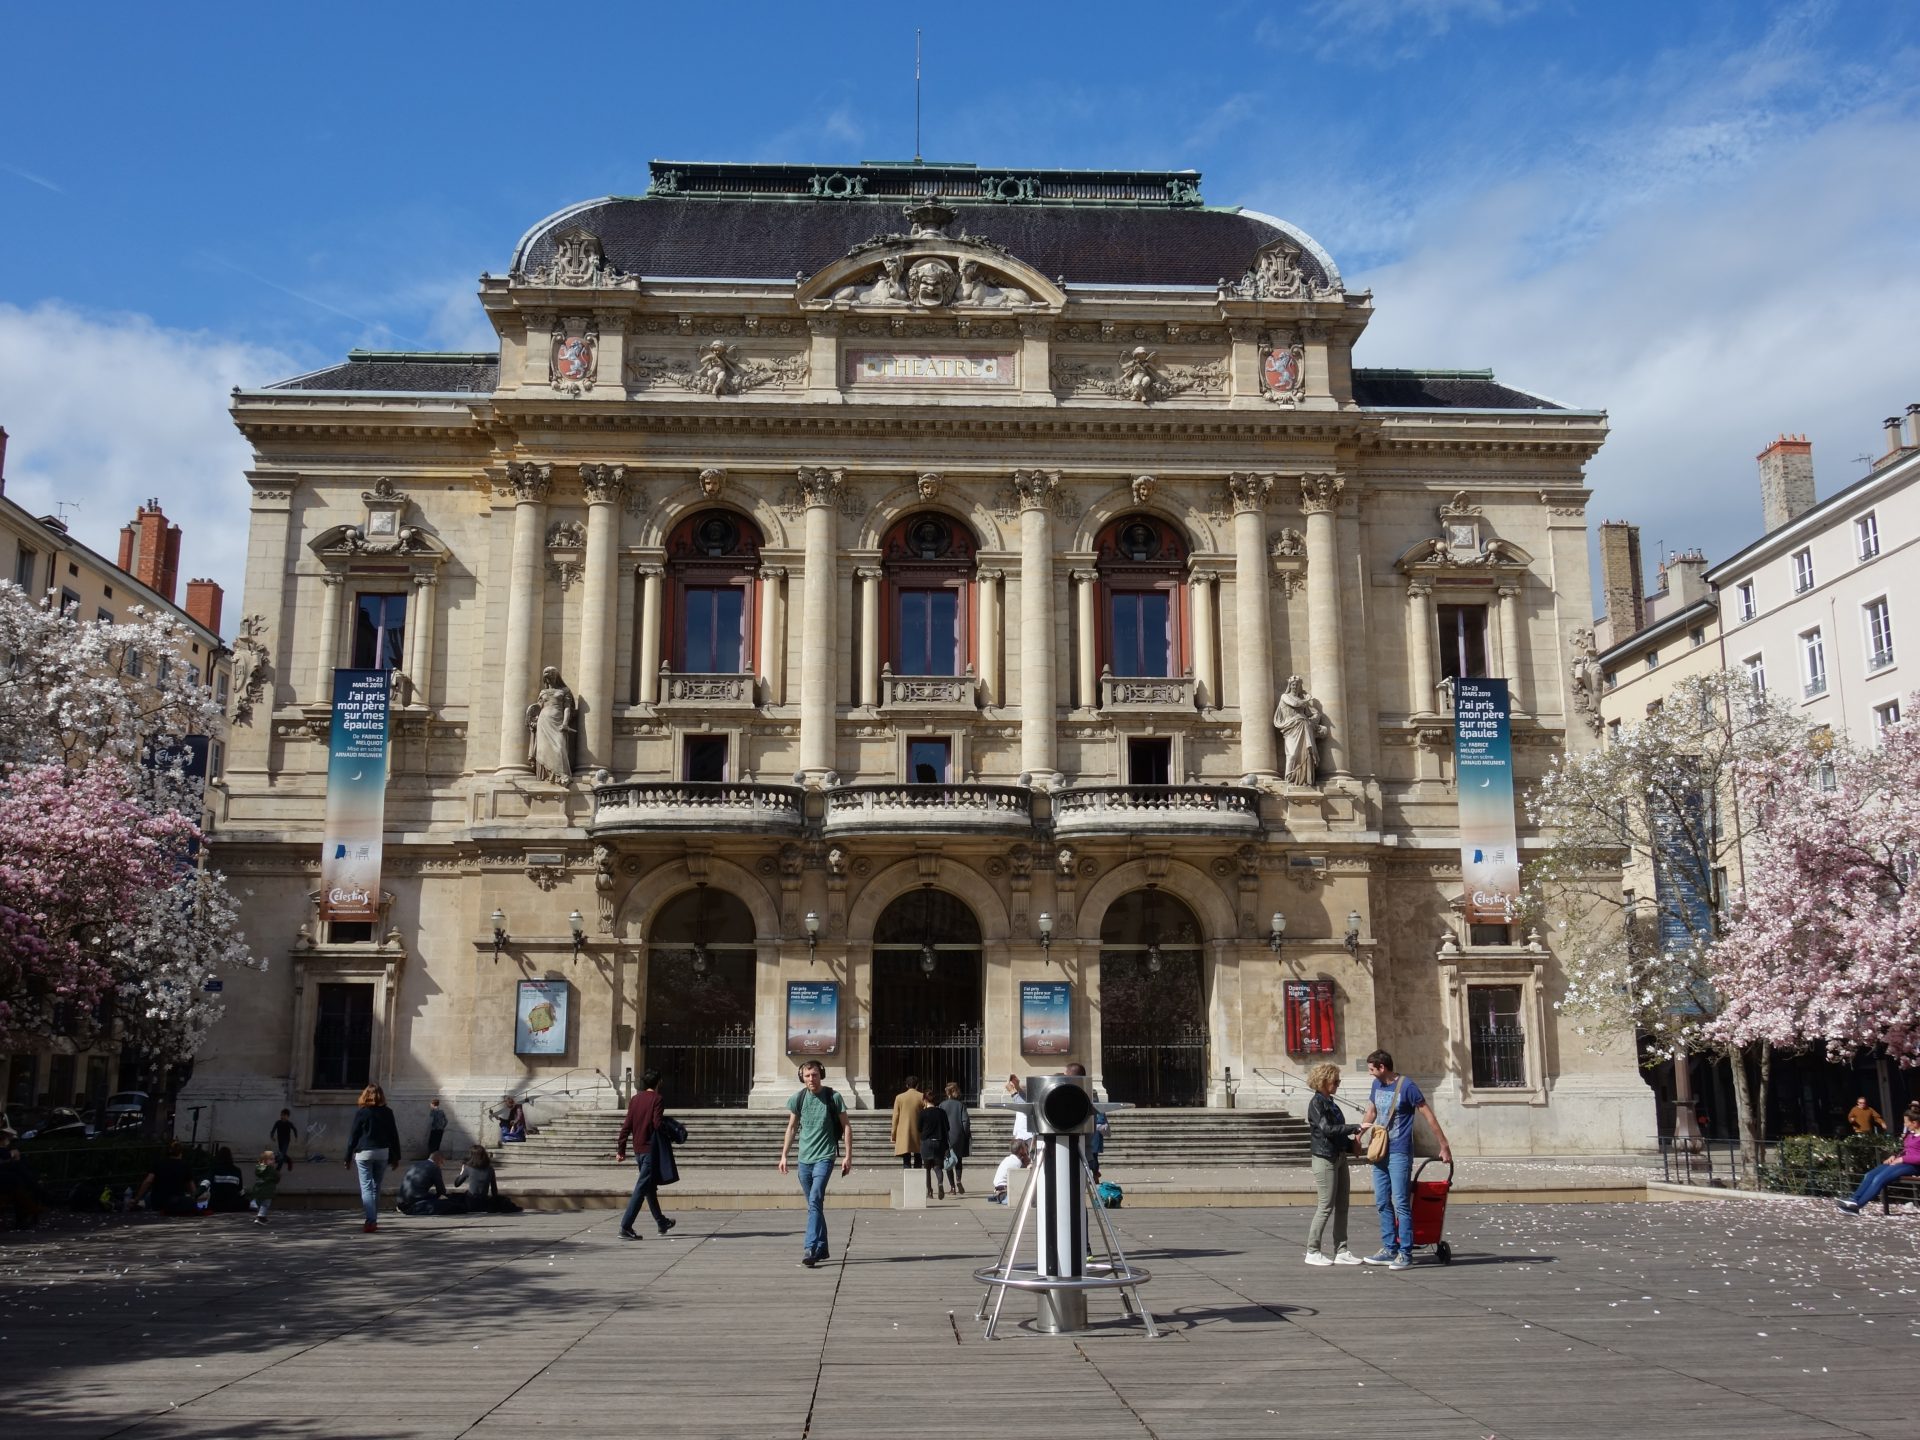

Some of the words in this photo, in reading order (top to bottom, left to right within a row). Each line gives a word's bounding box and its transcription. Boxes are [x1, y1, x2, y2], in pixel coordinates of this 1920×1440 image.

[880, 360, 981, 376] THEATRE
[348, 691, 364, 701] J'ai
[366, 691, 385, 702] pris
[362, 701, 385, 712] père
[1459, 700, 1473, 709] J'ai
[1476, 700, 1494, 711] pris
[1482, 710, 1504, 720] père
[343, 720, 384, 731] épaules
[1460, 729, 1498, 739] épaules
[329, 888, 370, 905] Célestins
